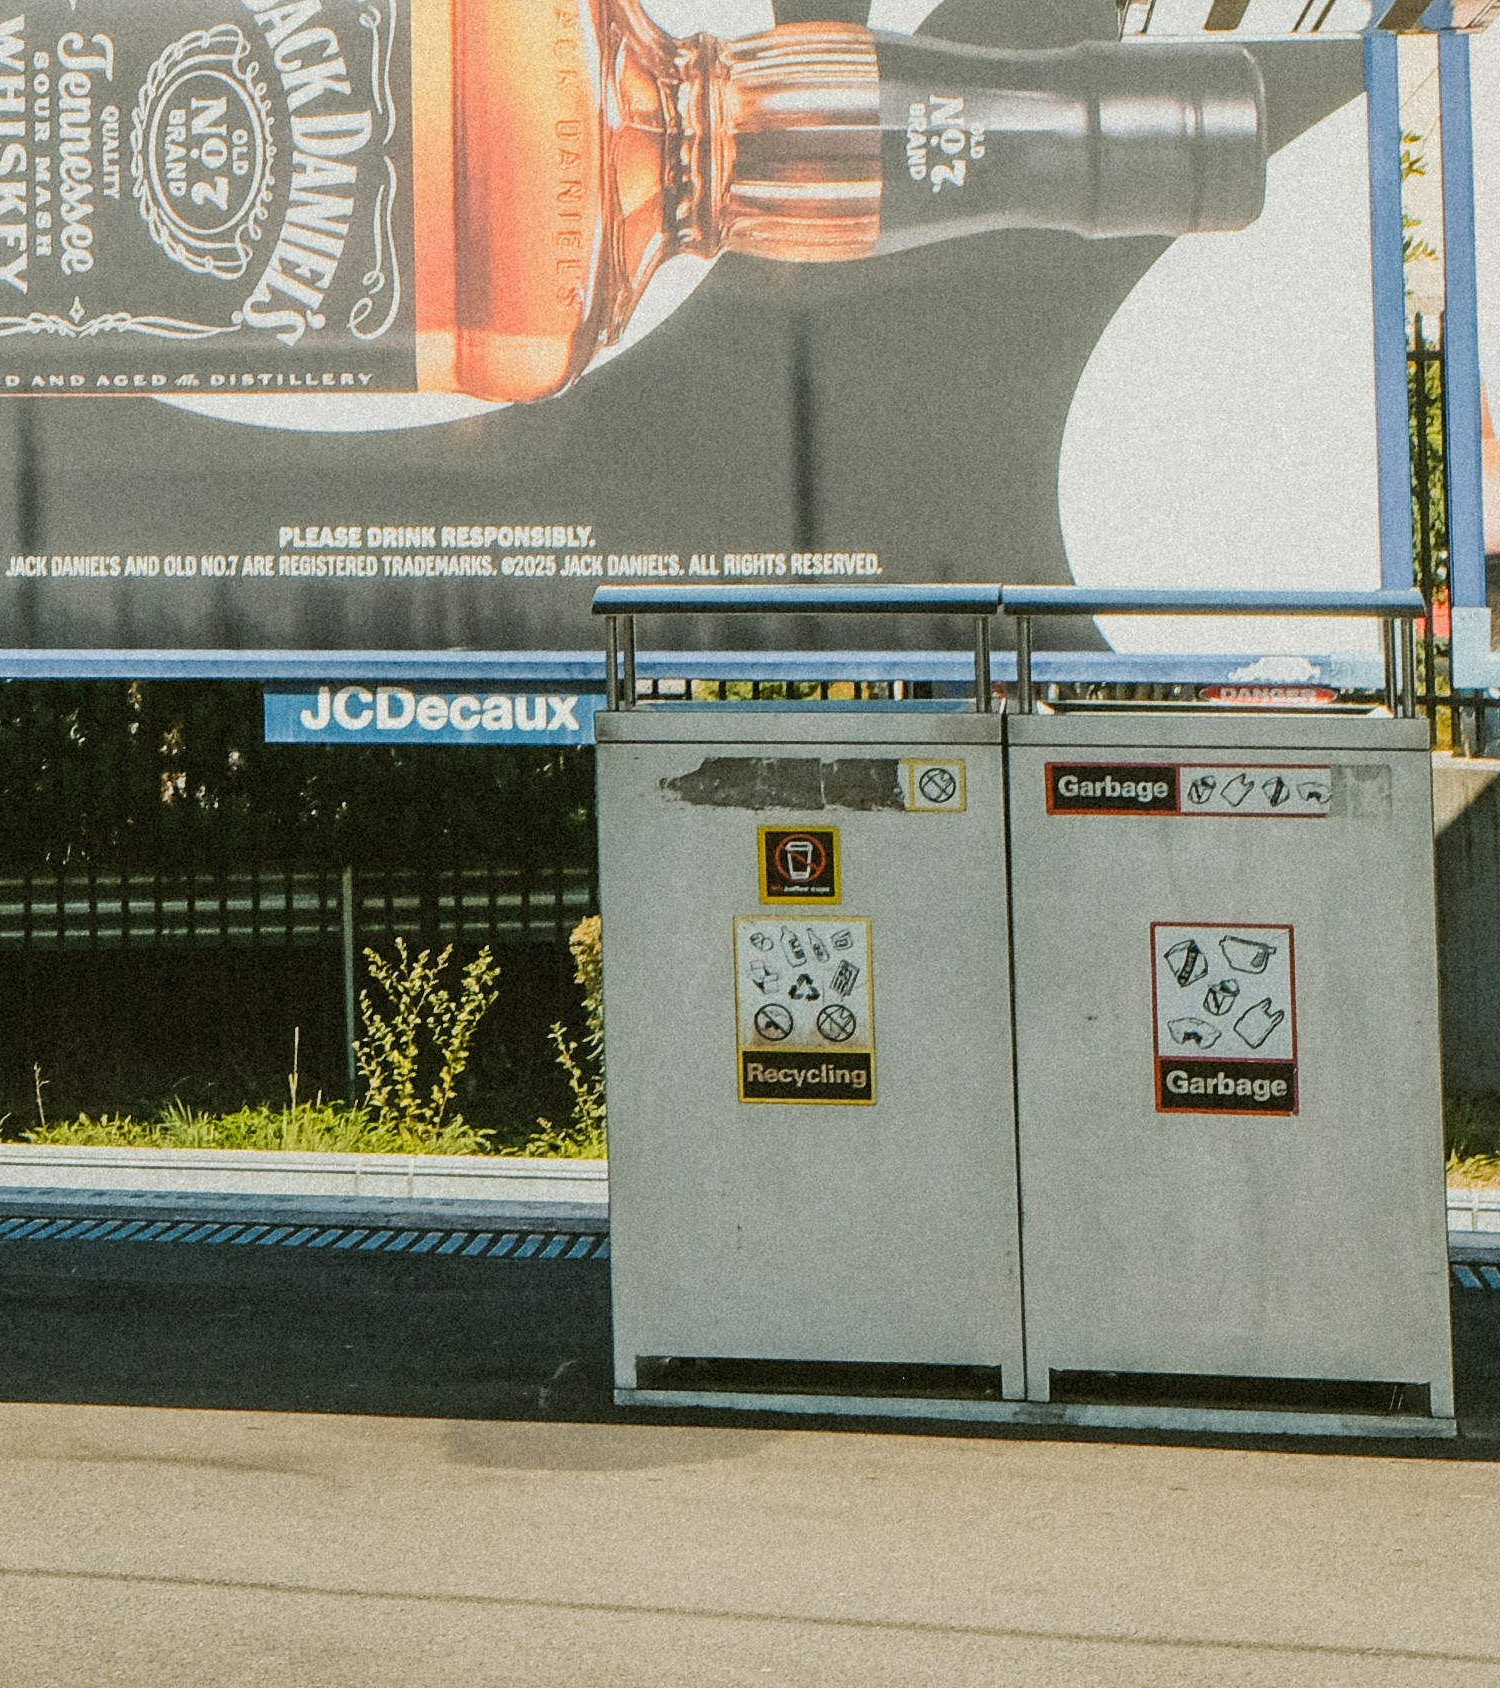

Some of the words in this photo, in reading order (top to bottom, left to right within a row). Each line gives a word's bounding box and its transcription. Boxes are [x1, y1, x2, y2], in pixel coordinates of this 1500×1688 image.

[33, 51, 51, 142] SOUR
[56, 31, 115, 276] Tennessee
[100, 105, 120, 200] QUALITY
[164, 108, 188, 198] BRAND
[231, 128, 249, 176] OLD
[906, 102, 928, 181] BRAND
[969, 122, 986, 160] OLD
[34, 155, 52, 257] MASH
[241, 109, 373, 347] DANIEL'S
[31, 374, 86, 388] AND
[209, 372, 373, 386] DISTILLERY
[279, 525, 363, 549] PLEASE
[366, 525, 437, 549] DRINK
[440, 525, 596, 549] RESPONSIBLY.
[4, 555, 48, 578] JACK
[50, 555, 121, 578] DANIEL'S
[123, 555, 160, 577] AND
[163, 555, 198, 577] OLD
[241, 555, 276, 577] ARE
[278, 555, 379, 577] REGISTERED
[559, 554, 604, 577] JACK
[688, 553, 720, 576] ALL
[723, 553, 787, 576] RIGHTS
[790, 552, 883, 576] RESERVED.
[300, 685, 581, 731] JCDecaux
[1057, 774, 1170, 802] Garbage
[746, 1062, 867, 1089] Recycling
[1165, 1069, 1288, 1102] Garbage
